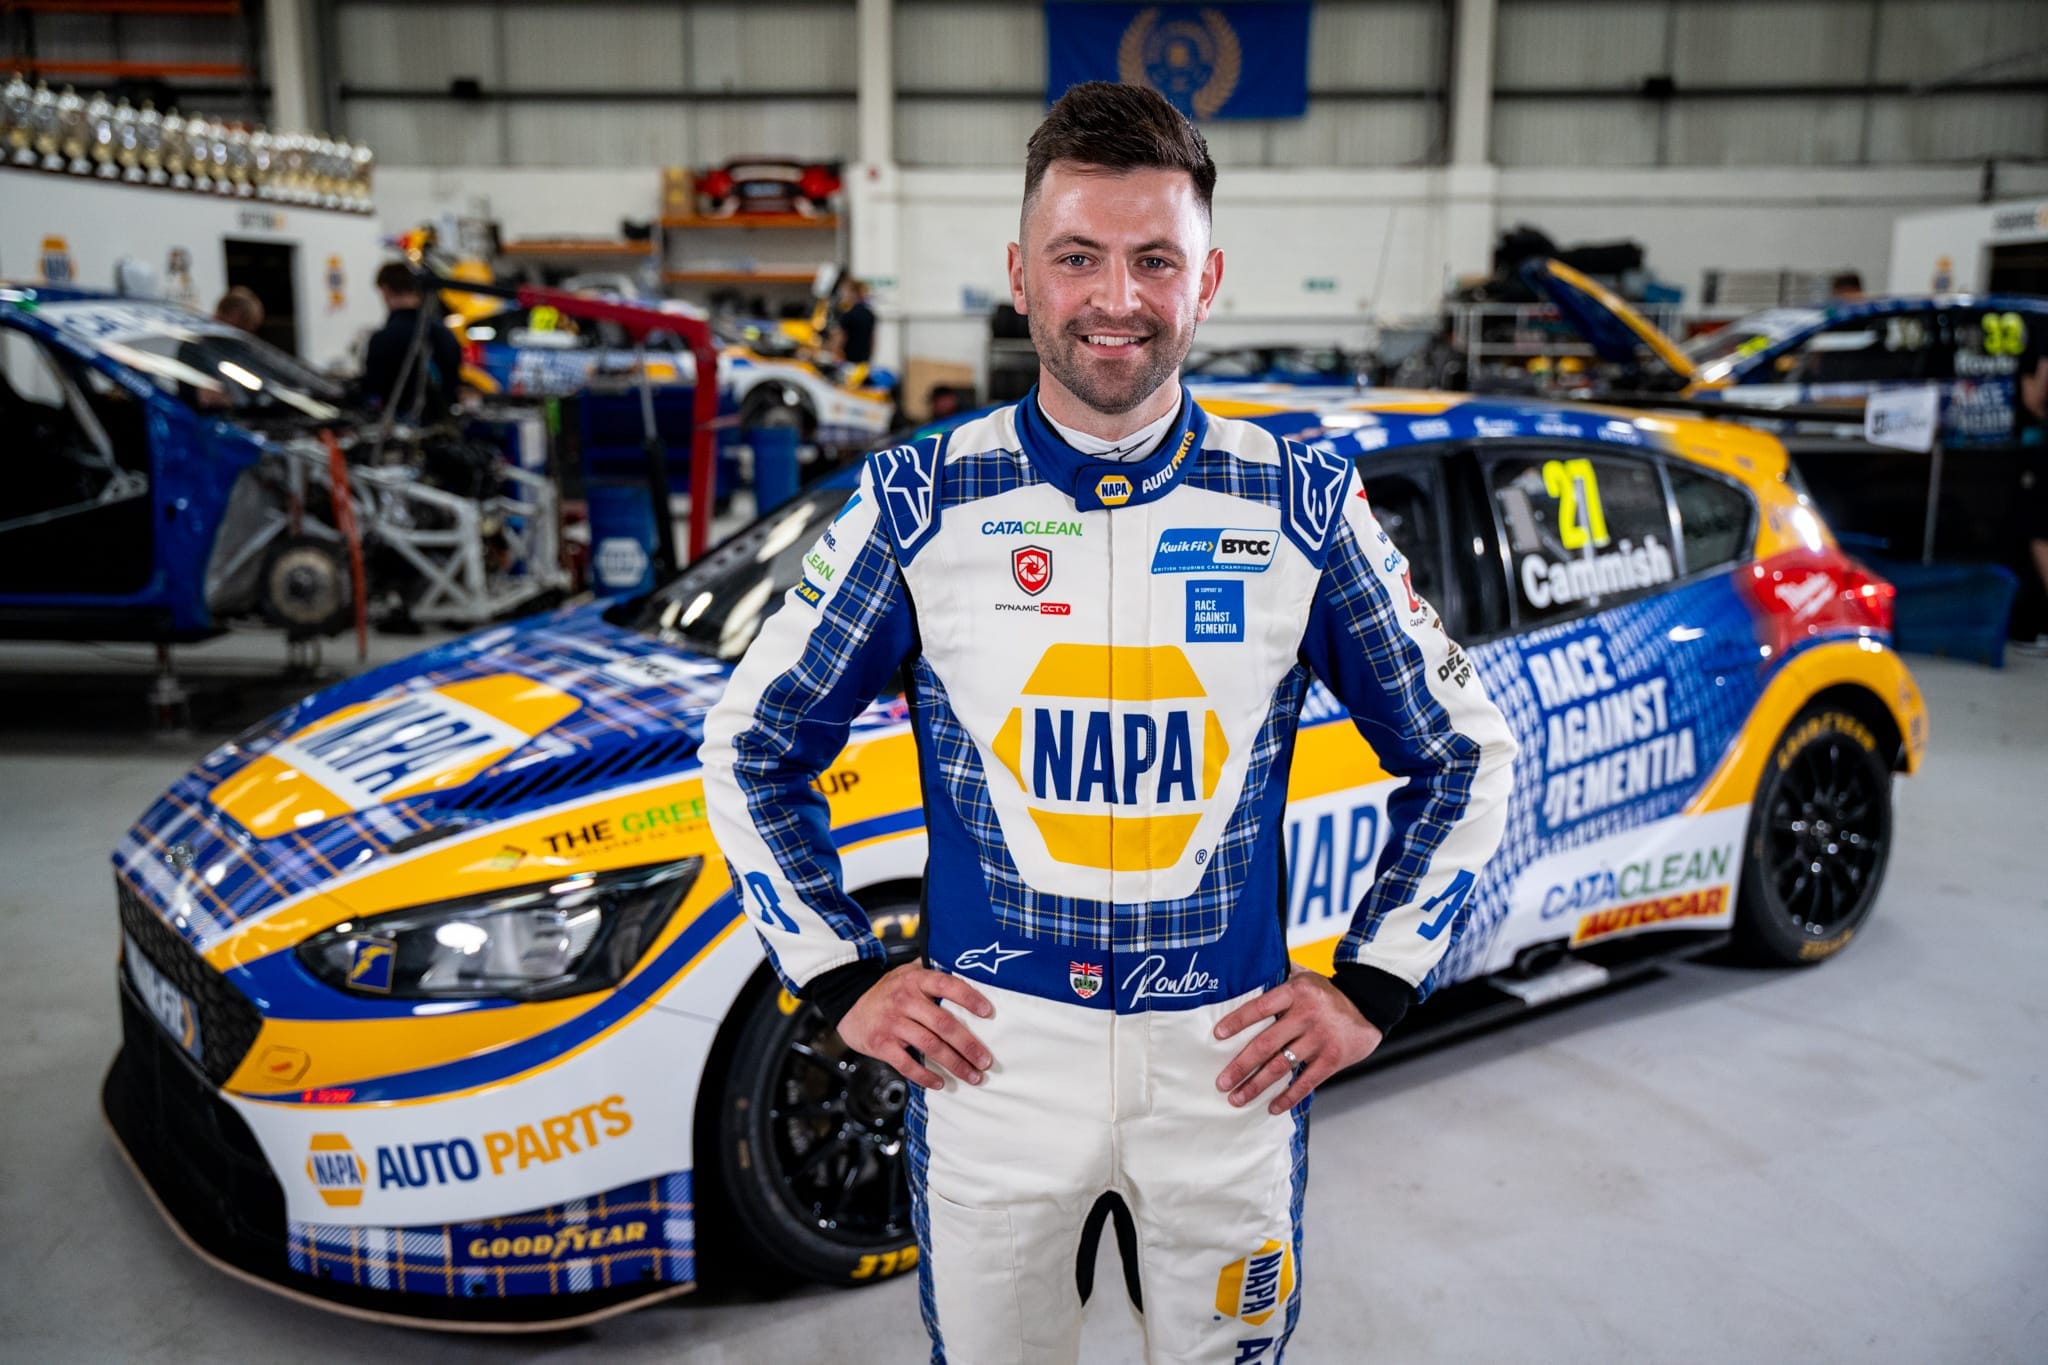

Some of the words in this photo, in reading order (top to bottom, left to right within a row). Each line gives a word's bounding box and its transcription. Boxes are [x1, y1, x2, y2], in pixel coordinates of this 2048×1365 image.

[1101, 483, 1128, 497] NAPA
[1142, 464, 1173, 494] AUTO
[1171, 431, 1195, 470] PARTS
[1542, 459, 1610, 549] 27
[1221, 539, 1270, 556] BTCC
[1521, 535, 1673, 609] Cammish
[995, 603, 1039, 612] DYNAMIC
[1041, 604, 1068, 613] CCTV
[1194, 600, 1216, 611] RACE
[1194, 612, 1230, 622] AGAINST
[1194, 624, 1237, 635] DEMENTIA
[1527, 635, 1616, 710] RACE
[1033, 708, 1197, 805] NAPA
[1546, 677, 1668, 772] AGAINST
[543, 819, 613, 853] THE
[814, 771, 860, 796] UP
[1543, 727, 1696, 828] DEMENTIA
[1541, 845, 1730, 920] CATACLEAN
[1578, 887, 1723, 940] AUTOCAR
[314, 1153, 362, 1187] NAPA
[376, 1138, 480, 1190] AUTO
[484, 1094, 633, 1176] PARTS
[468, 1222, 648, 1258] GOODYEAR
[1241, 1251, 1283, 1315] NAPA
